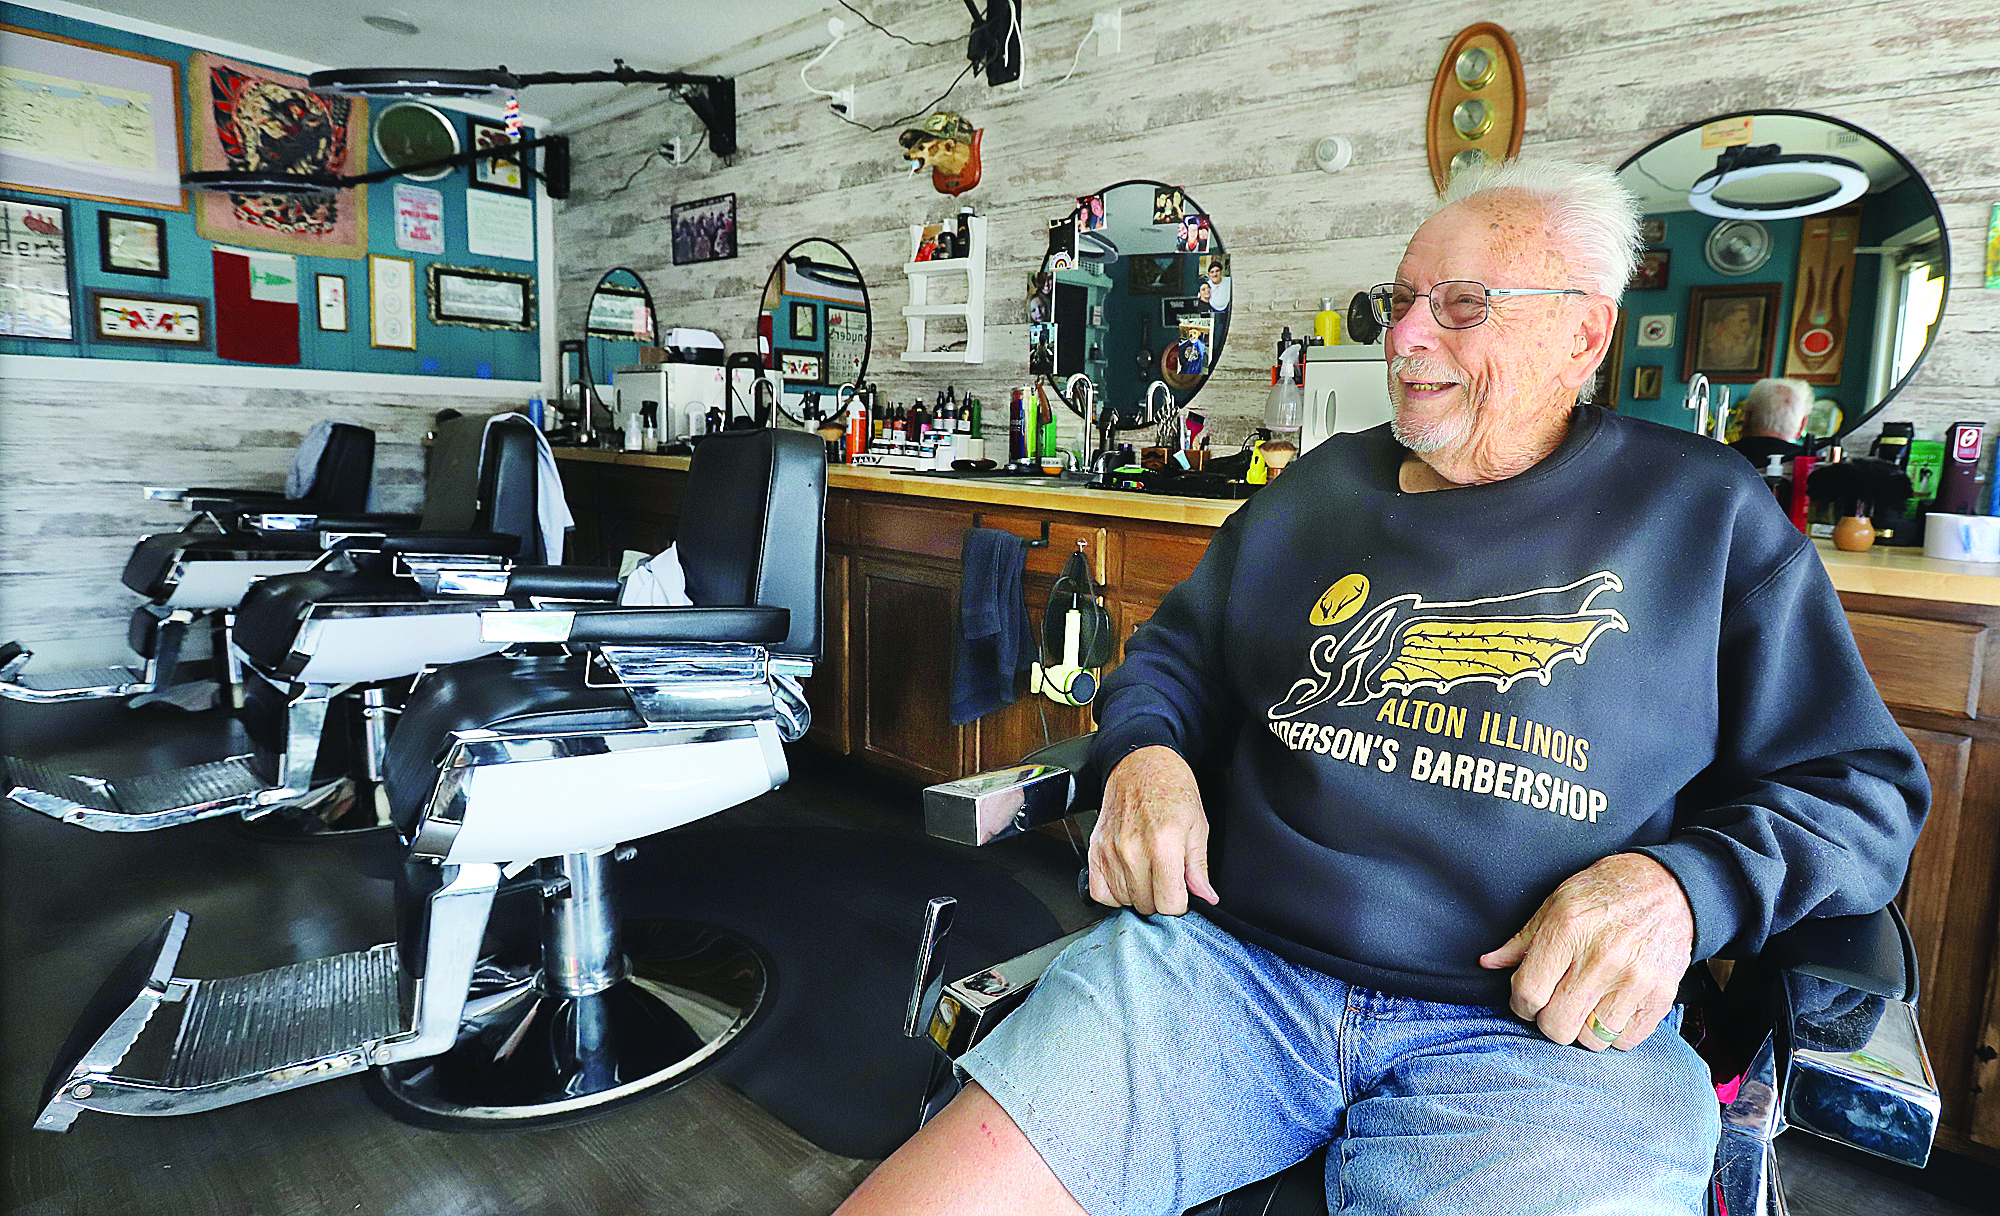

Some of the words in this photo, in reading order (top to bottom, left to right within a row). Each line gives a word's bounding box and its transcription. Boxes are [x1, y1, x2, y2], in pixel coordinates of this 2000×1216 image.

[1376, 697, 1468, 739] ALTON
[1479, 710, 1590, 772] ILLINOIS
[1410, 745, 1608, 824] BARBERSHOP
